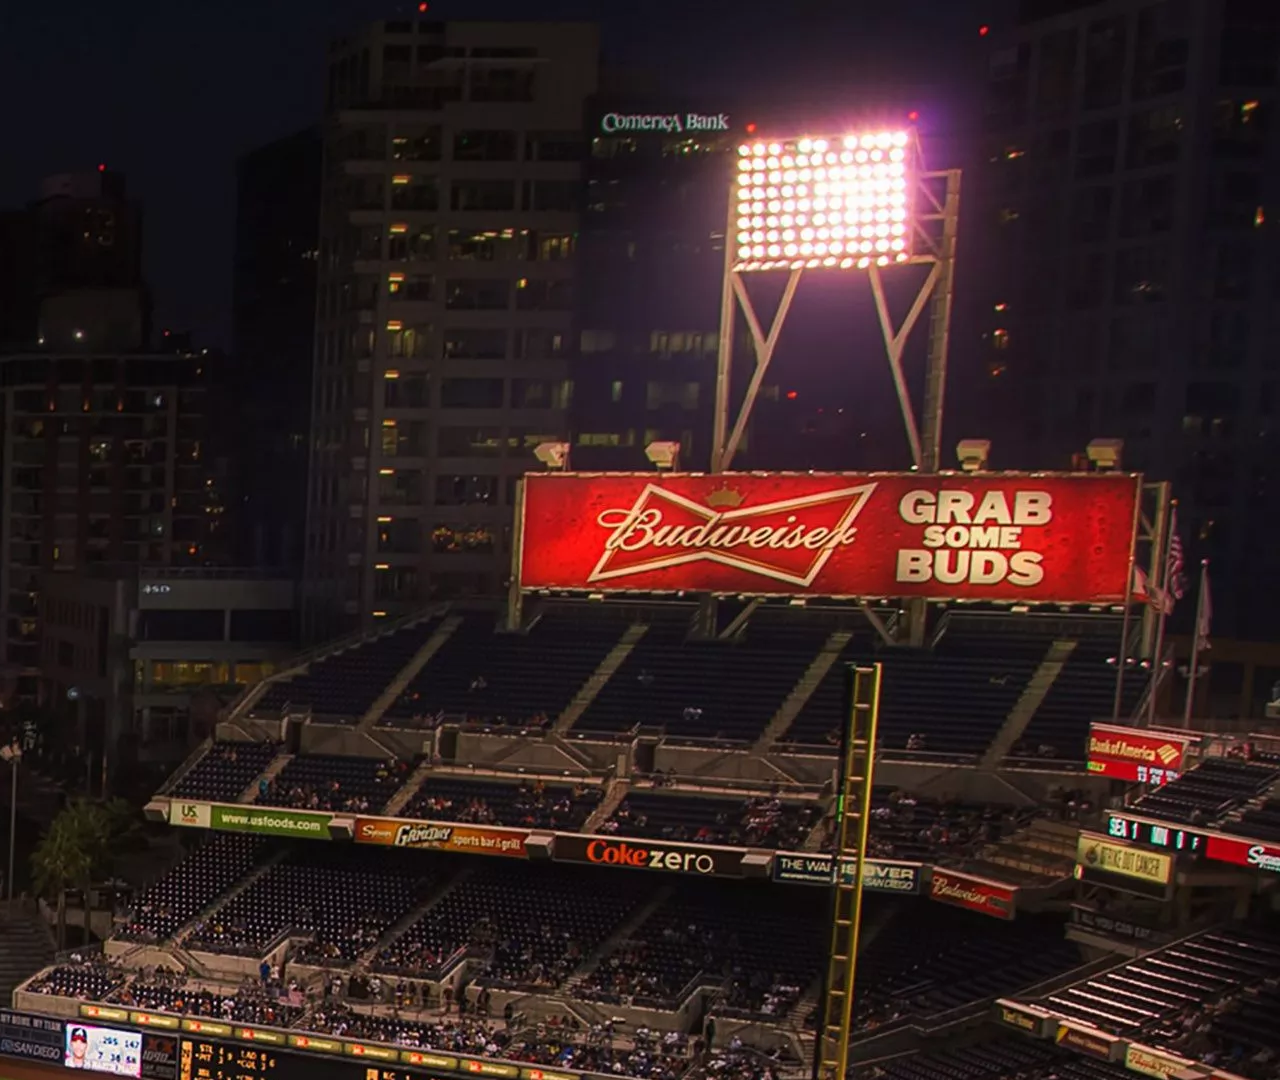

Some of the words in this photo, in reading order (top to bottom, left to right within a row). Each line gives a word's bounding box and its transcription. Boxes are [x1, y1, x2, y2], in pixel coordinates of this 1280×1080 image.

[685, 113, 729, 129] Bank
[899, 490, 1052, 525] GRAB
[597, 509, 858, 552] Budweiser
[922, 525, 1022, 548] SOME
[896, 549, 1044, 586] BUDS
[1090, 737, 1110, 752] Bank
[1120, 742, 1155, 761] America
[221, 813, 321, 831] www.usfoods.com
[1109, 818, 1127, 837] SEA
[452, 835, 479, 848] sports
[481, 836, 495, 848] bar
[502, 838, 520, 852] grill
[586, 839, 648, 866] Coke
[649, 850, 712, 873] zero
[780, 859, 804, 871] THE
[806, 860, 833, 873] WAI
[862, 863, 914, 880] OVER
[863, 877, 883, 888] SAN
[884, 879, 913, 890] DIEGO
[932, 876, 987, 904] Budweiser
